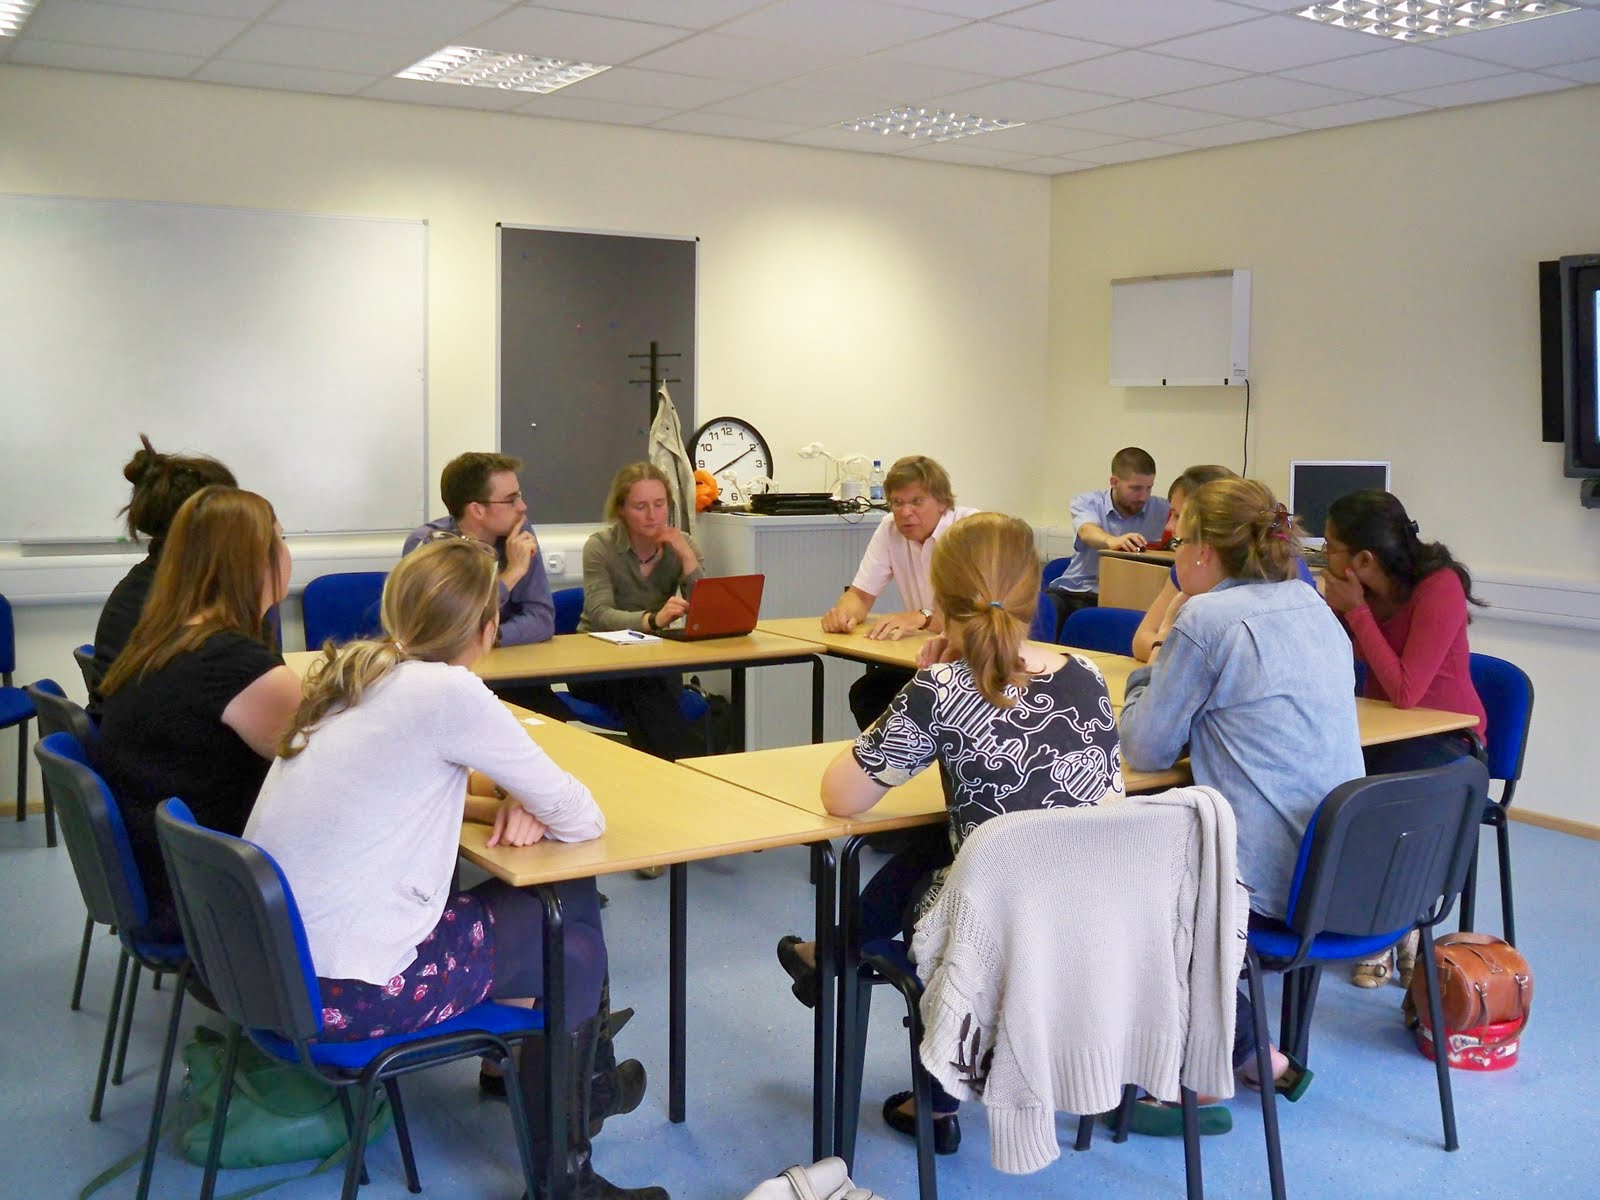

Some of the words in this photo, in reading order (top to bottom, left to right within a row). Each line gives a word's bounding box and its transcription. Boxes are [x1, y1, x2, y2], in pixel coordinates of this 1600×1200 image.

[708, 432, 719, 440] 11
[720, 427, 733, 436] 12
[738, 432, 744, 440] 1
[700, 443, 713, 452] 10
[749, 443, 757, 452] 2
[698, 459, 705, 468] 9
[755, 459, 763, 468] 3
[731, 492, 738, 501] 6
